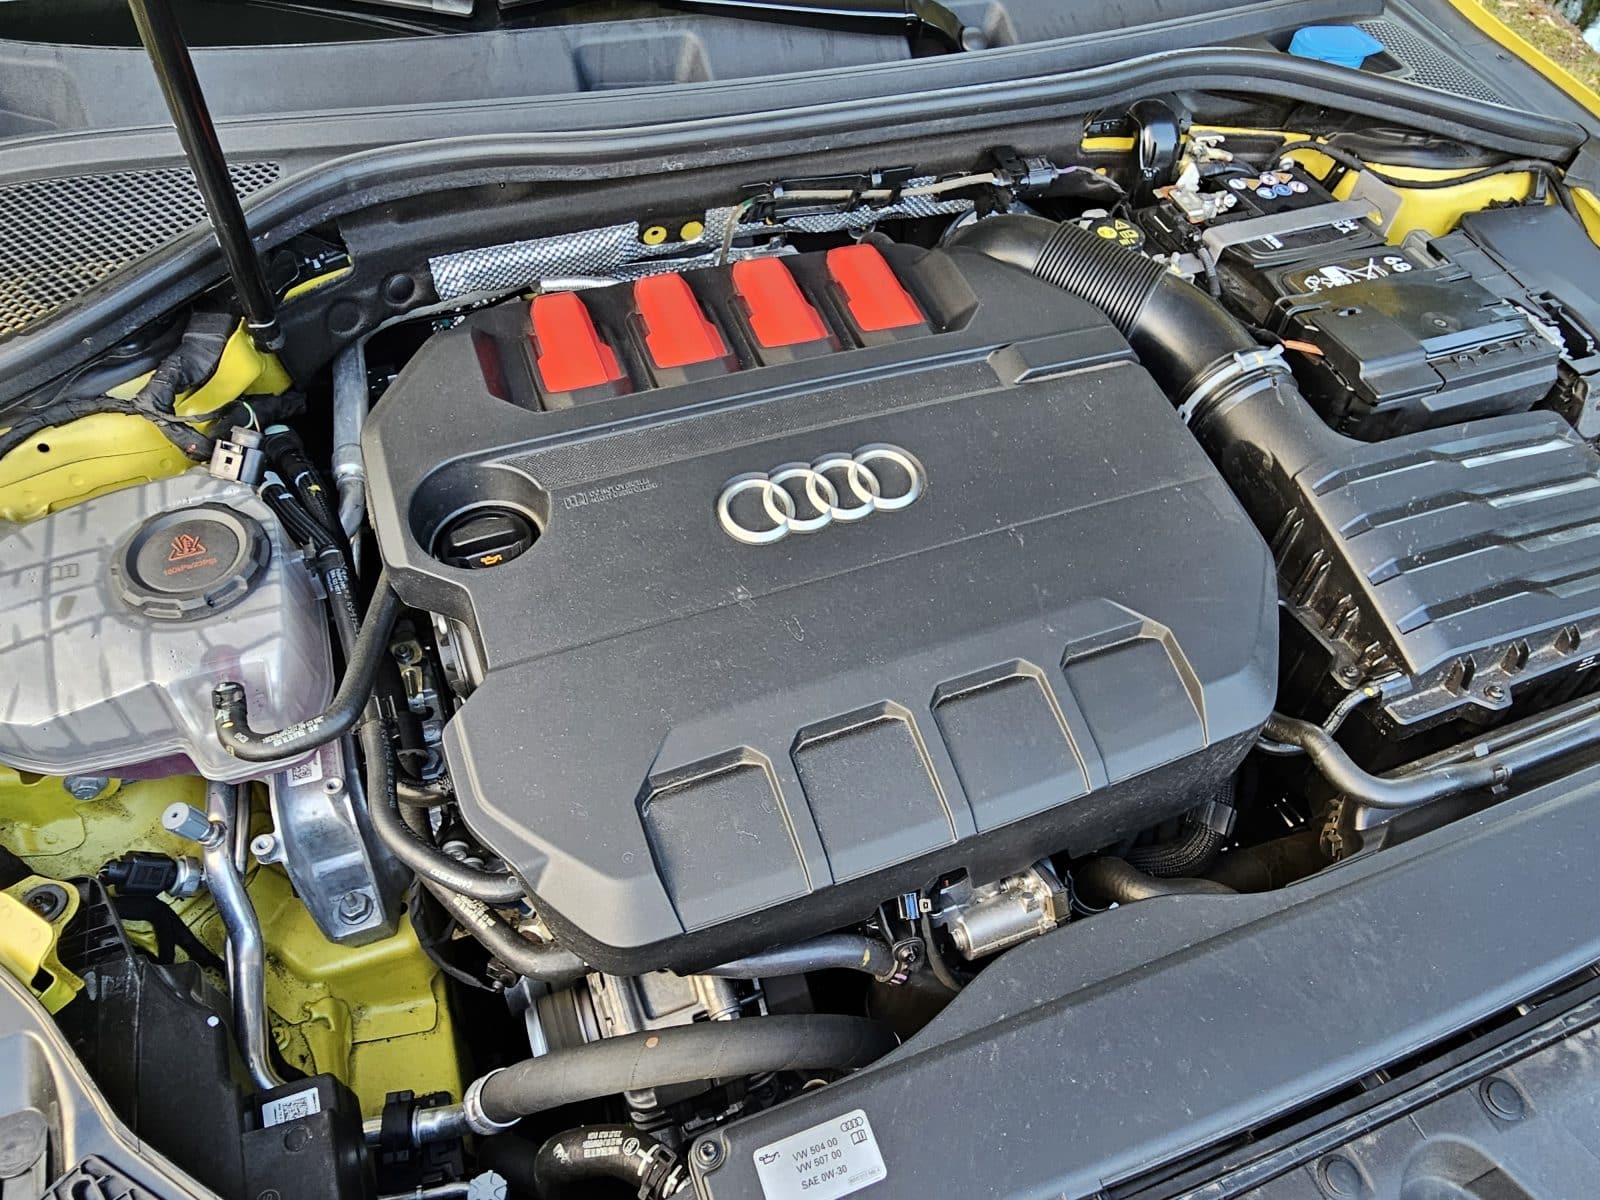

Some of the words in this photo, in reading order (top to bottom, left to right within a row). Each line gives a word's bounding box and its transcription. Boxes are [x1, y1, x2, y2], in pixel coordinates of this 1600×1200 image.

[792, 1148, 808, 1162] VW
[810, 1142, 826, 1155] 504
[827, 1137, 838, 1148] 00
[796, 1160, 812, 1173] VW
[814, 1154, 829, 1167] 507
[831, 1149, 842, 1160] 00
[801, 1175, 820, 1190] SAE
[821, 1164, 848, 1182] 0W-30
